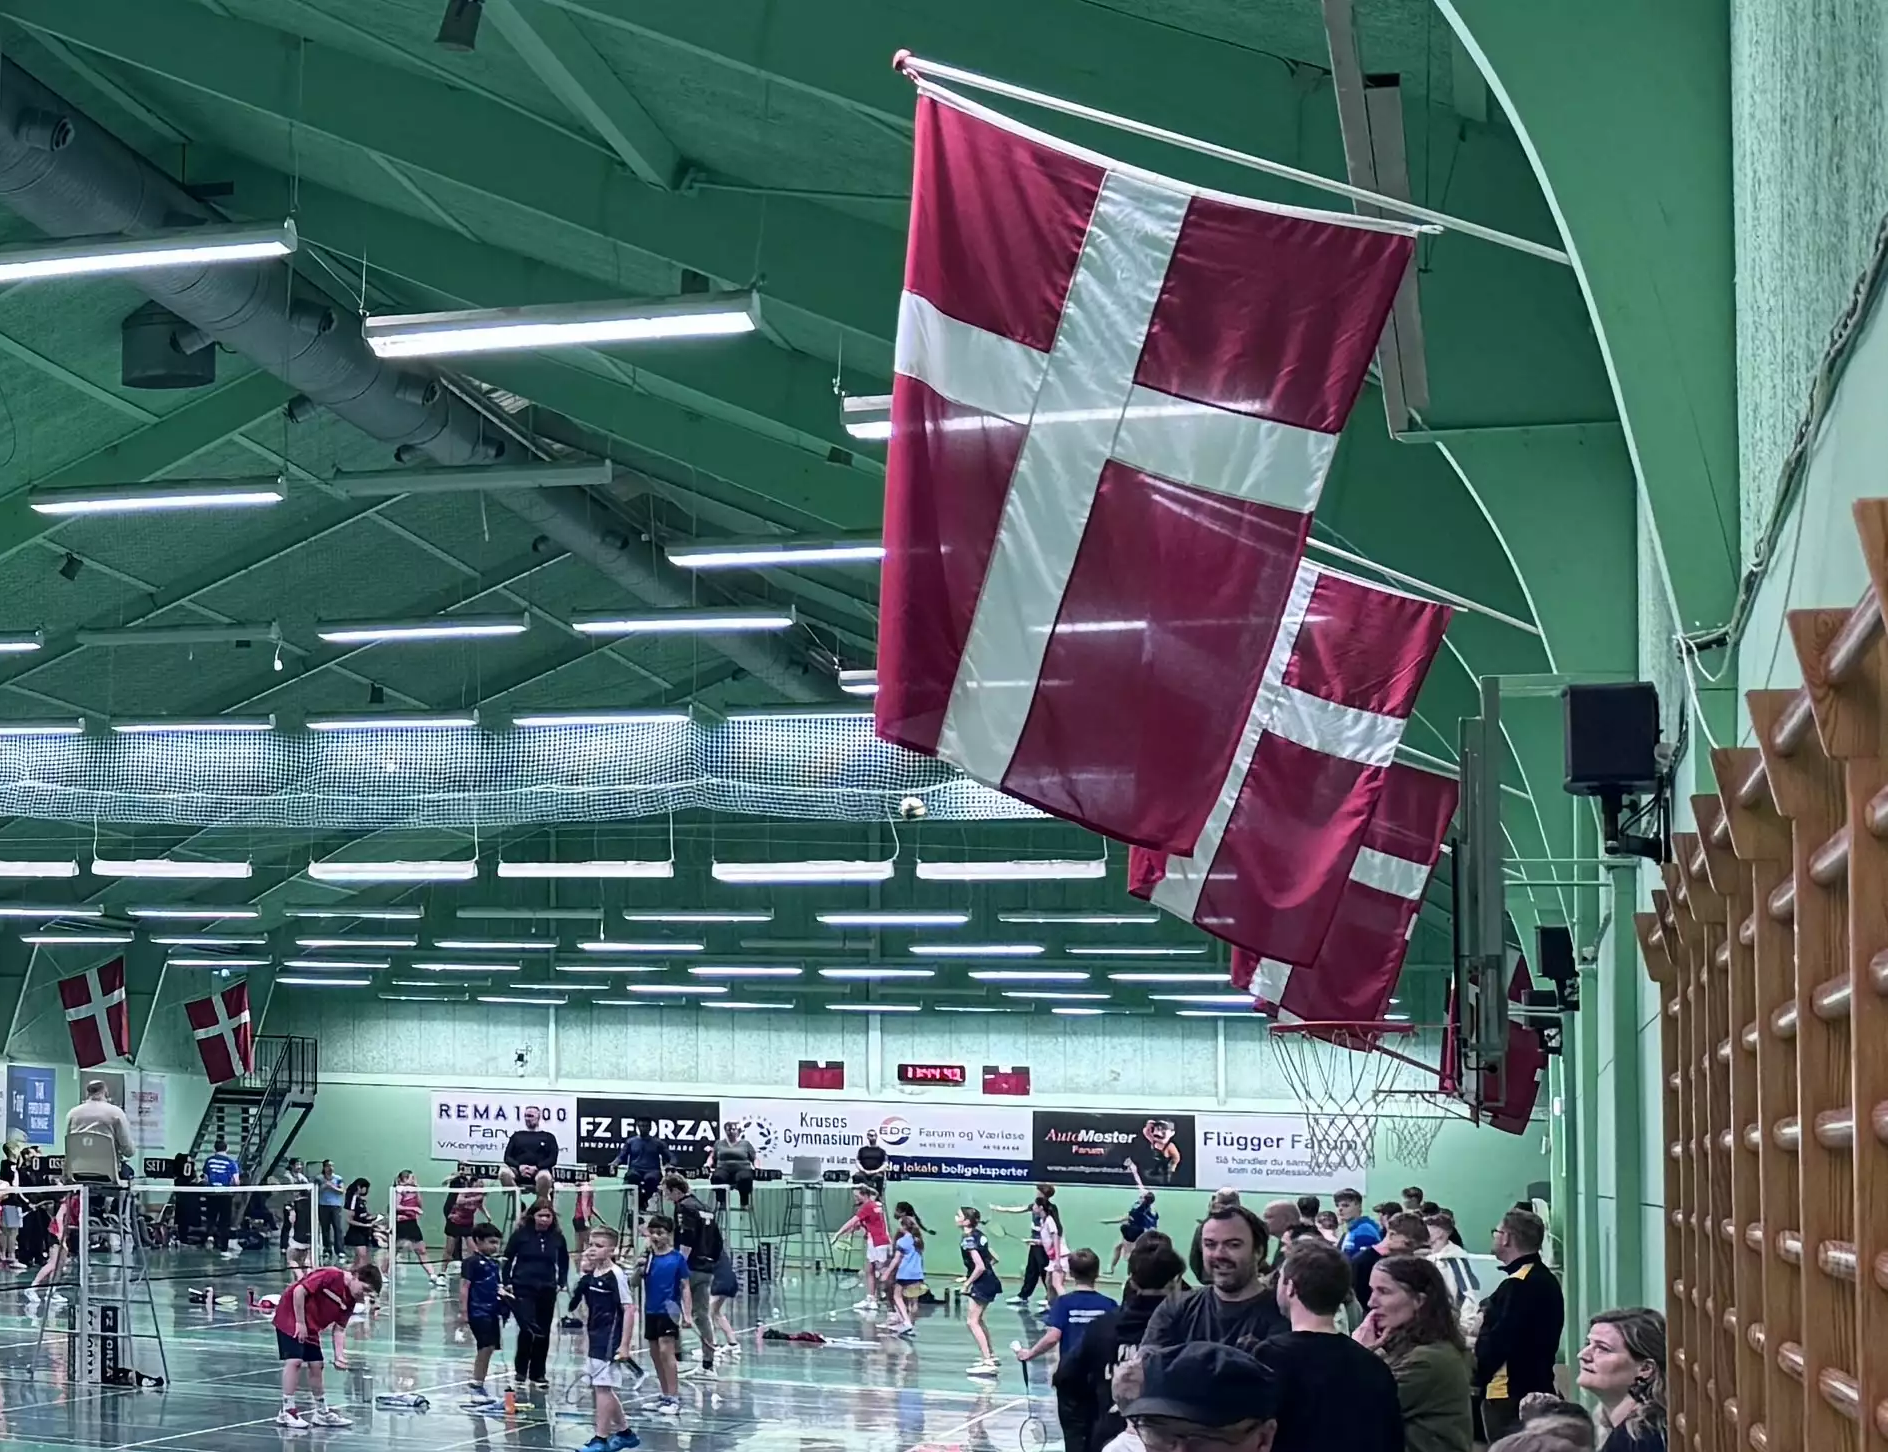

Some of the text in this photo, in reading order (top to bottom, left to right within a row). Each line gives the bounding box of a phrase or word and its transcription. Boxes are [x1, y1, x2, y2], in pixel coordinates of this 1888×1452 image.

[439, 1104, 567, 1122] REMA 100
[800, 1111, 847, 1128] Kruses
[469, 1124, 511, 1139] Faru
[580, 1116, 612, 1138] FZ
[879, 1126, 911, 1136] EDC
[918, 1127, 956, 1138] Farum
[958, 1130, 974, 1141] og
[783, 1128, 864, 1148] Gymnasium
[1044, 1127, 1137, 1144] AutoMester
[1203, 1132, 1285, 1152] Flügger
[1071, 1145, 1105, 1155] Farum
[903, 1161, 939, 1173] lokale
[941, 1163, 1029, 1177] boligeksperter
[1232, 1157, 1268, 1166] handler
[1270, 1158, 1284, 1167] du
[1250, 1167, 1263, 1176] de
